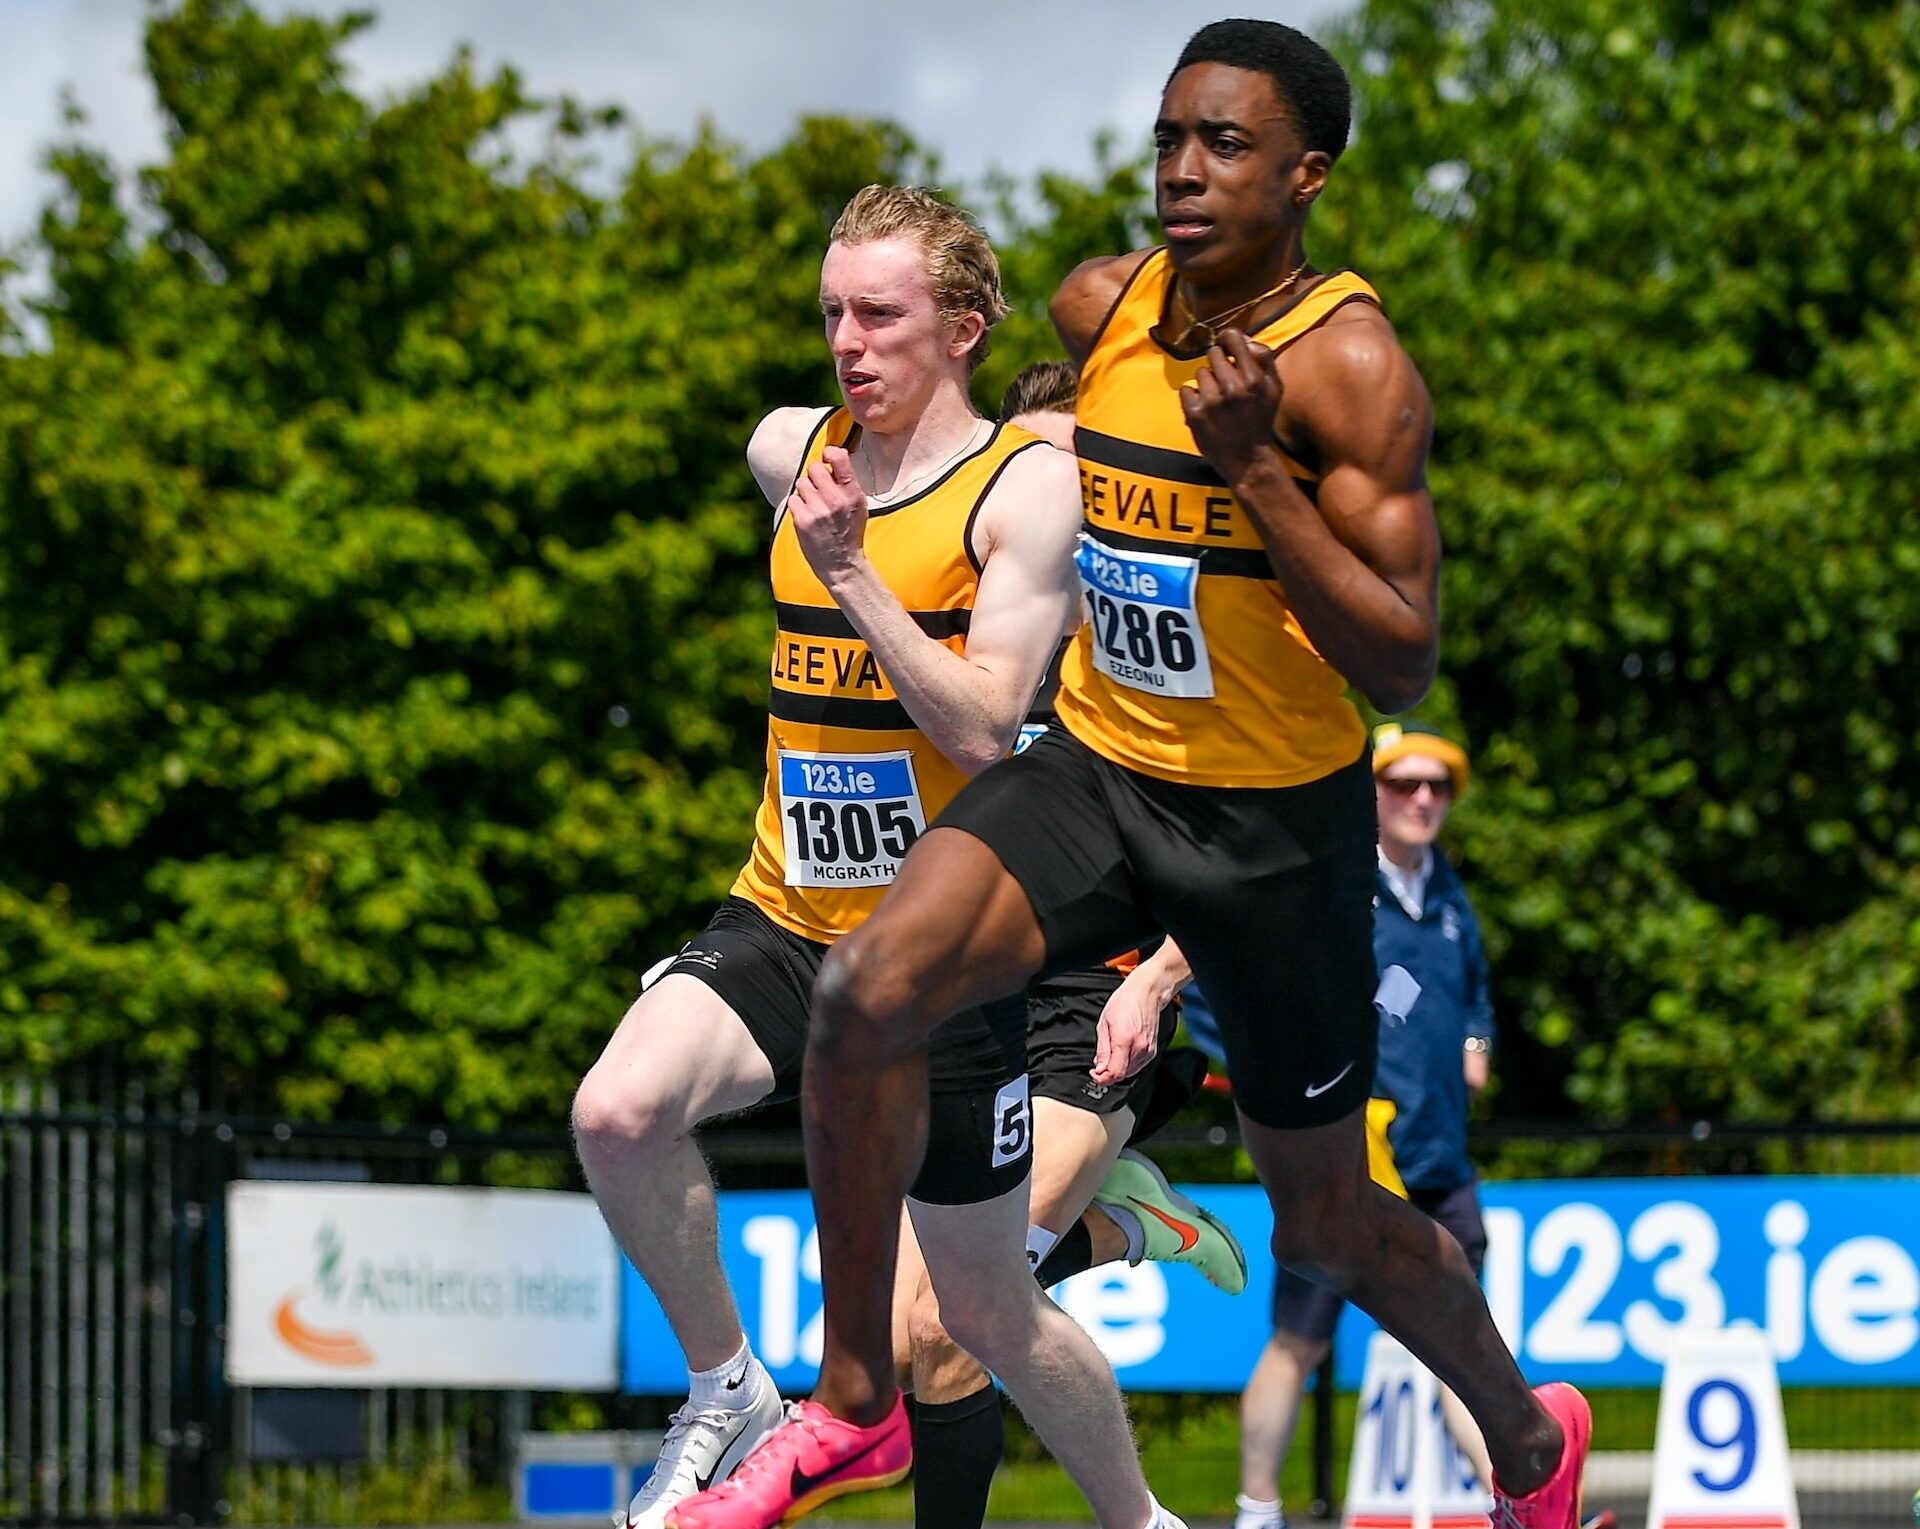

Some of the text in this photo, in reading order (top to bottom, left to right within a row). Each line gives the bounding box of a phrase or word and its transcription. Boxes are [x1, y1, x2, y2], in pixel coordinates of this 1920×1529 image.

[1091, 551, 1159, 598] 123.ie
[1085, 588, 1197, 672] 1286
[774, 638, 883, 690] LEEVA
[1109, 660, 1166, 687] EZEONU
[800, 763, 876, 794] 123.ie
[786, 800, 918, 863] 1305
[813, 863, 896, 879] MCGRATH
[999, 1099, 1025, 1156] 5
[1481, 1200, 1920, 1364] 123ie
[1686, 1380, 1758, 1492] 9
